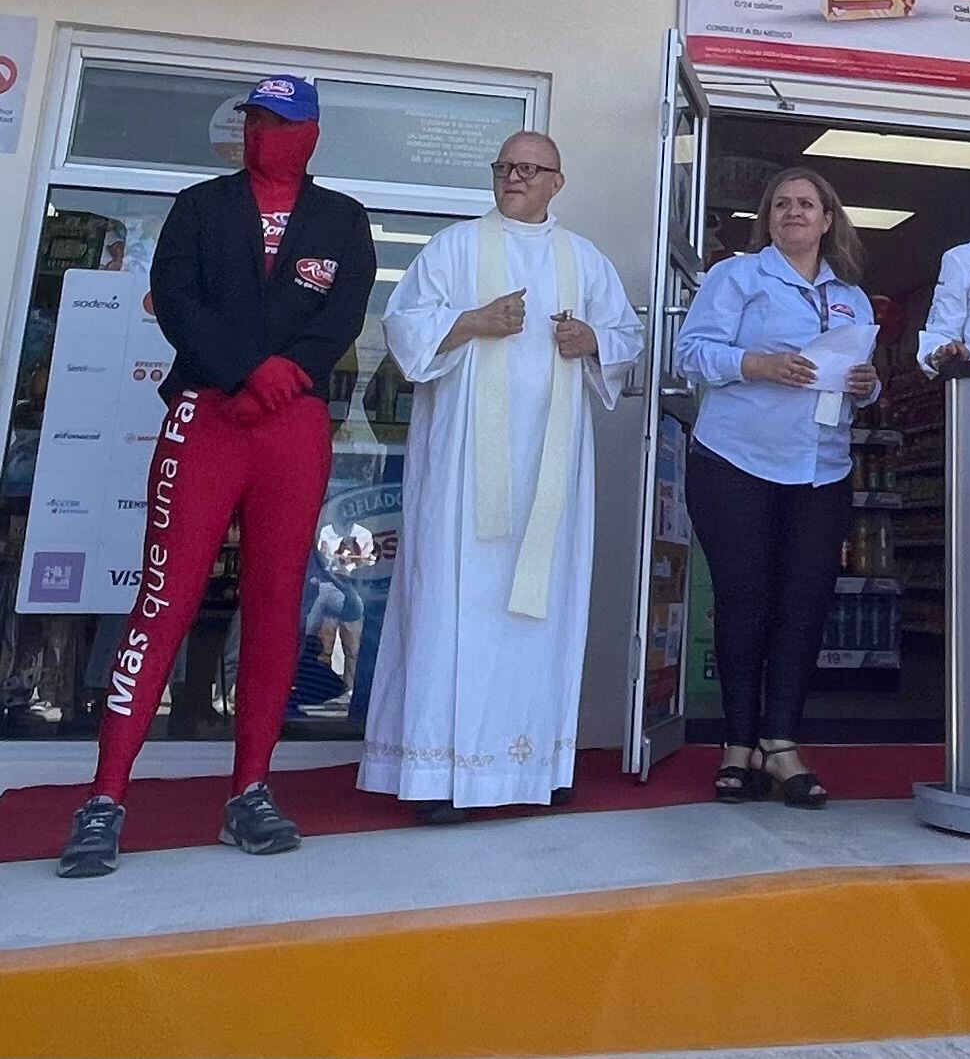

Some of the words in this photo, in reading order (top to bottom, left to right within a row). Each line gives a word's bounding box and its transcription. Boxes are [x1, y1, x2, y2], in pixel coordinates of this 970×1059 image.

[72, 295, 120, 310] sodexo
[152, 457, 179, 529] una
[142, 543, 170, 619] que
[106, 627, 150, 717] Más
